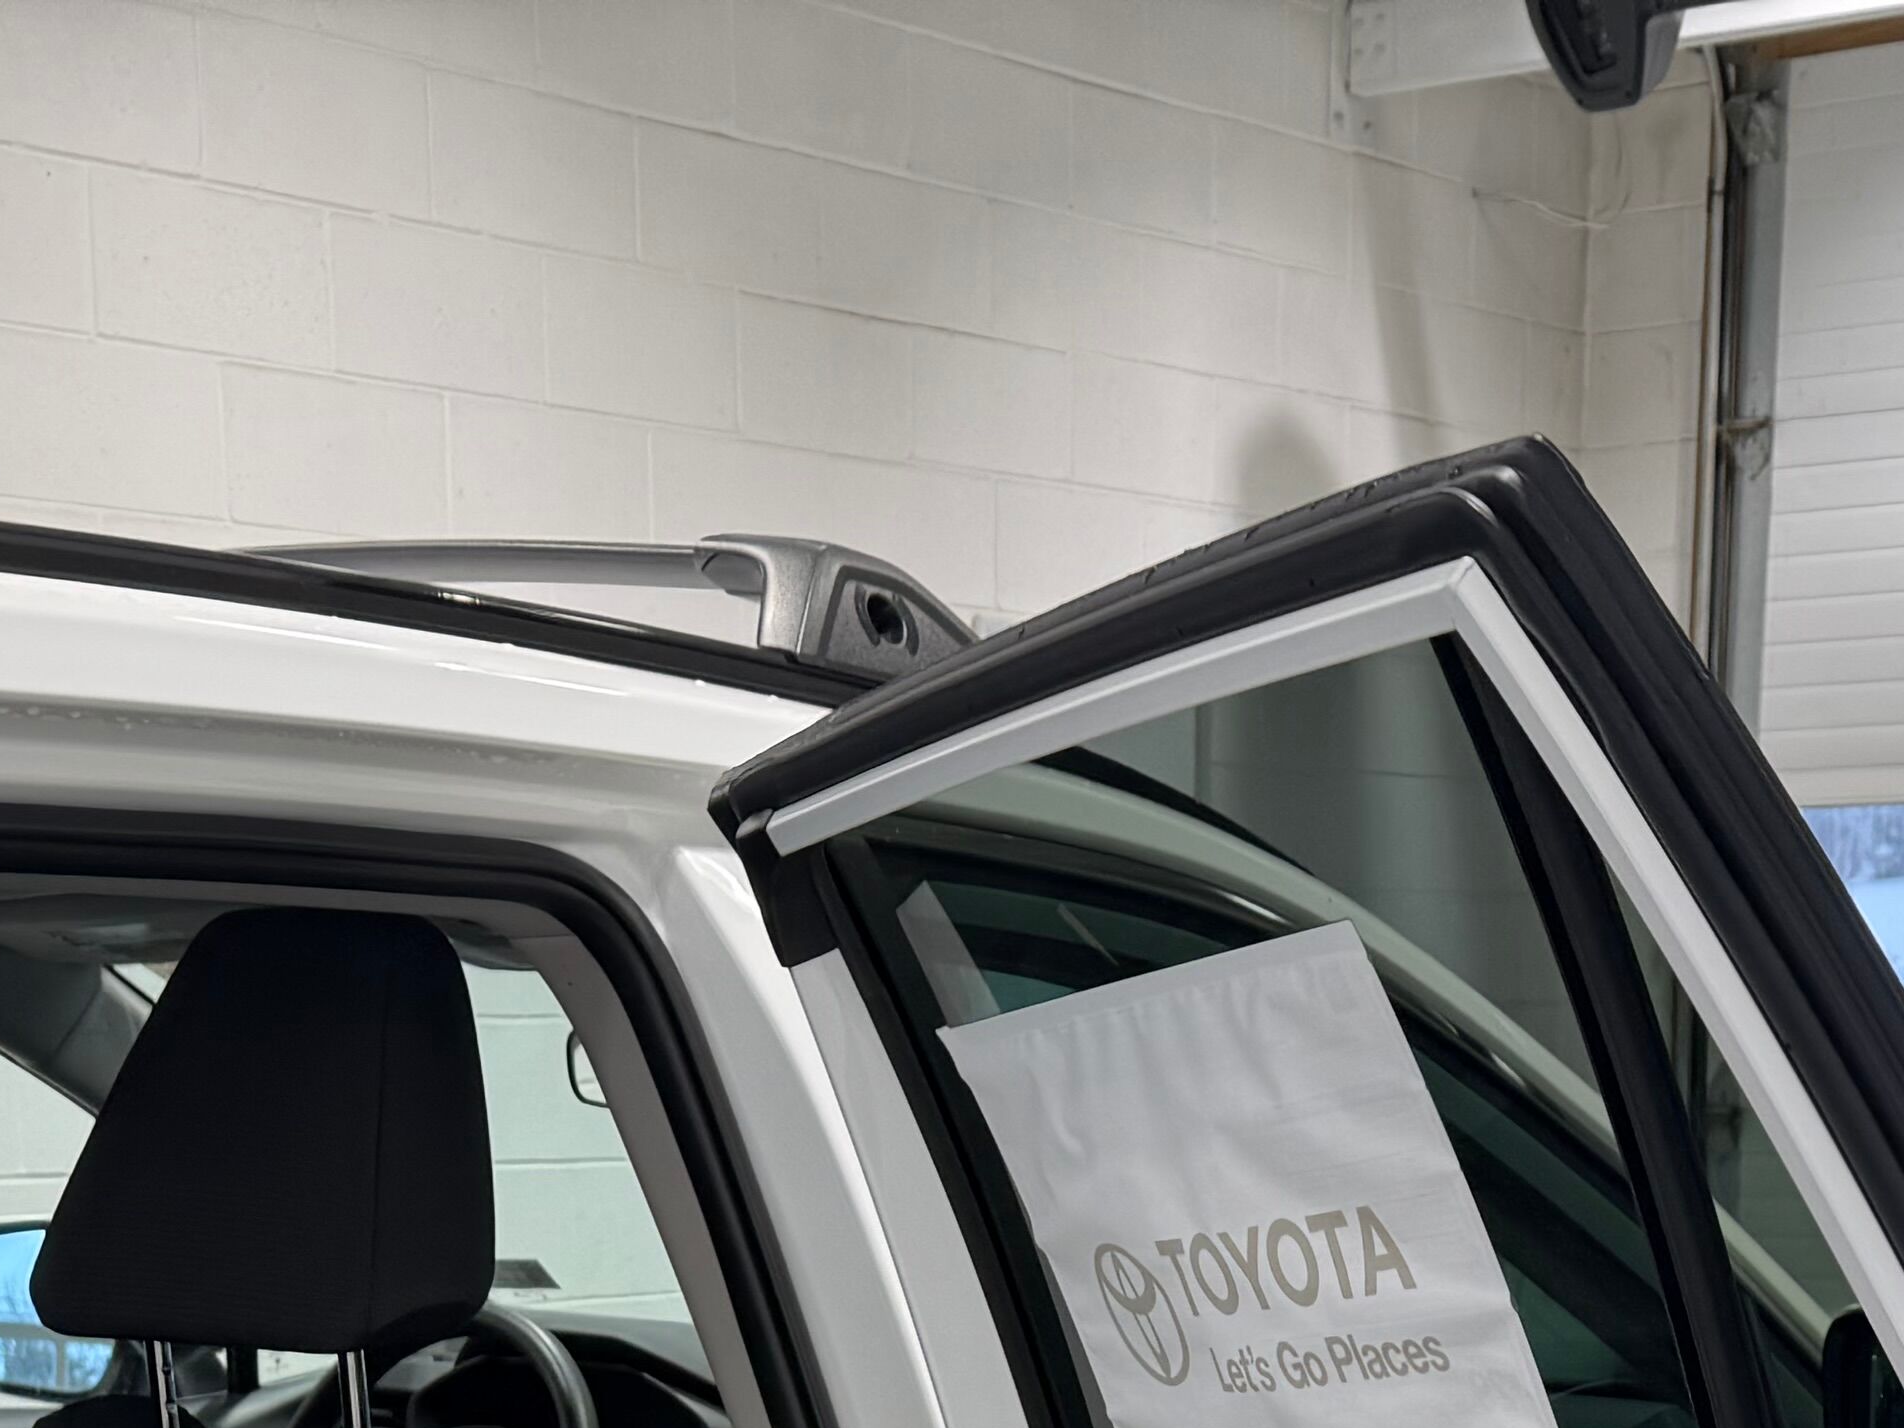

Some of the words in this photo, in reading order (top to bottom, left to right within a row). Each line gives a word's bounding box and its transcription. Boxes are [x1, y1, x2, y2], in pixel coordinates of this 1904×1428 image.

[1154, 1205, 1417, 1317] TOYOTA
[1209, 1344, 1277, 1393] Let's
[1276, 1341, 1329, 1390] Go
[1324, 1334, 1451, 1383] Places
